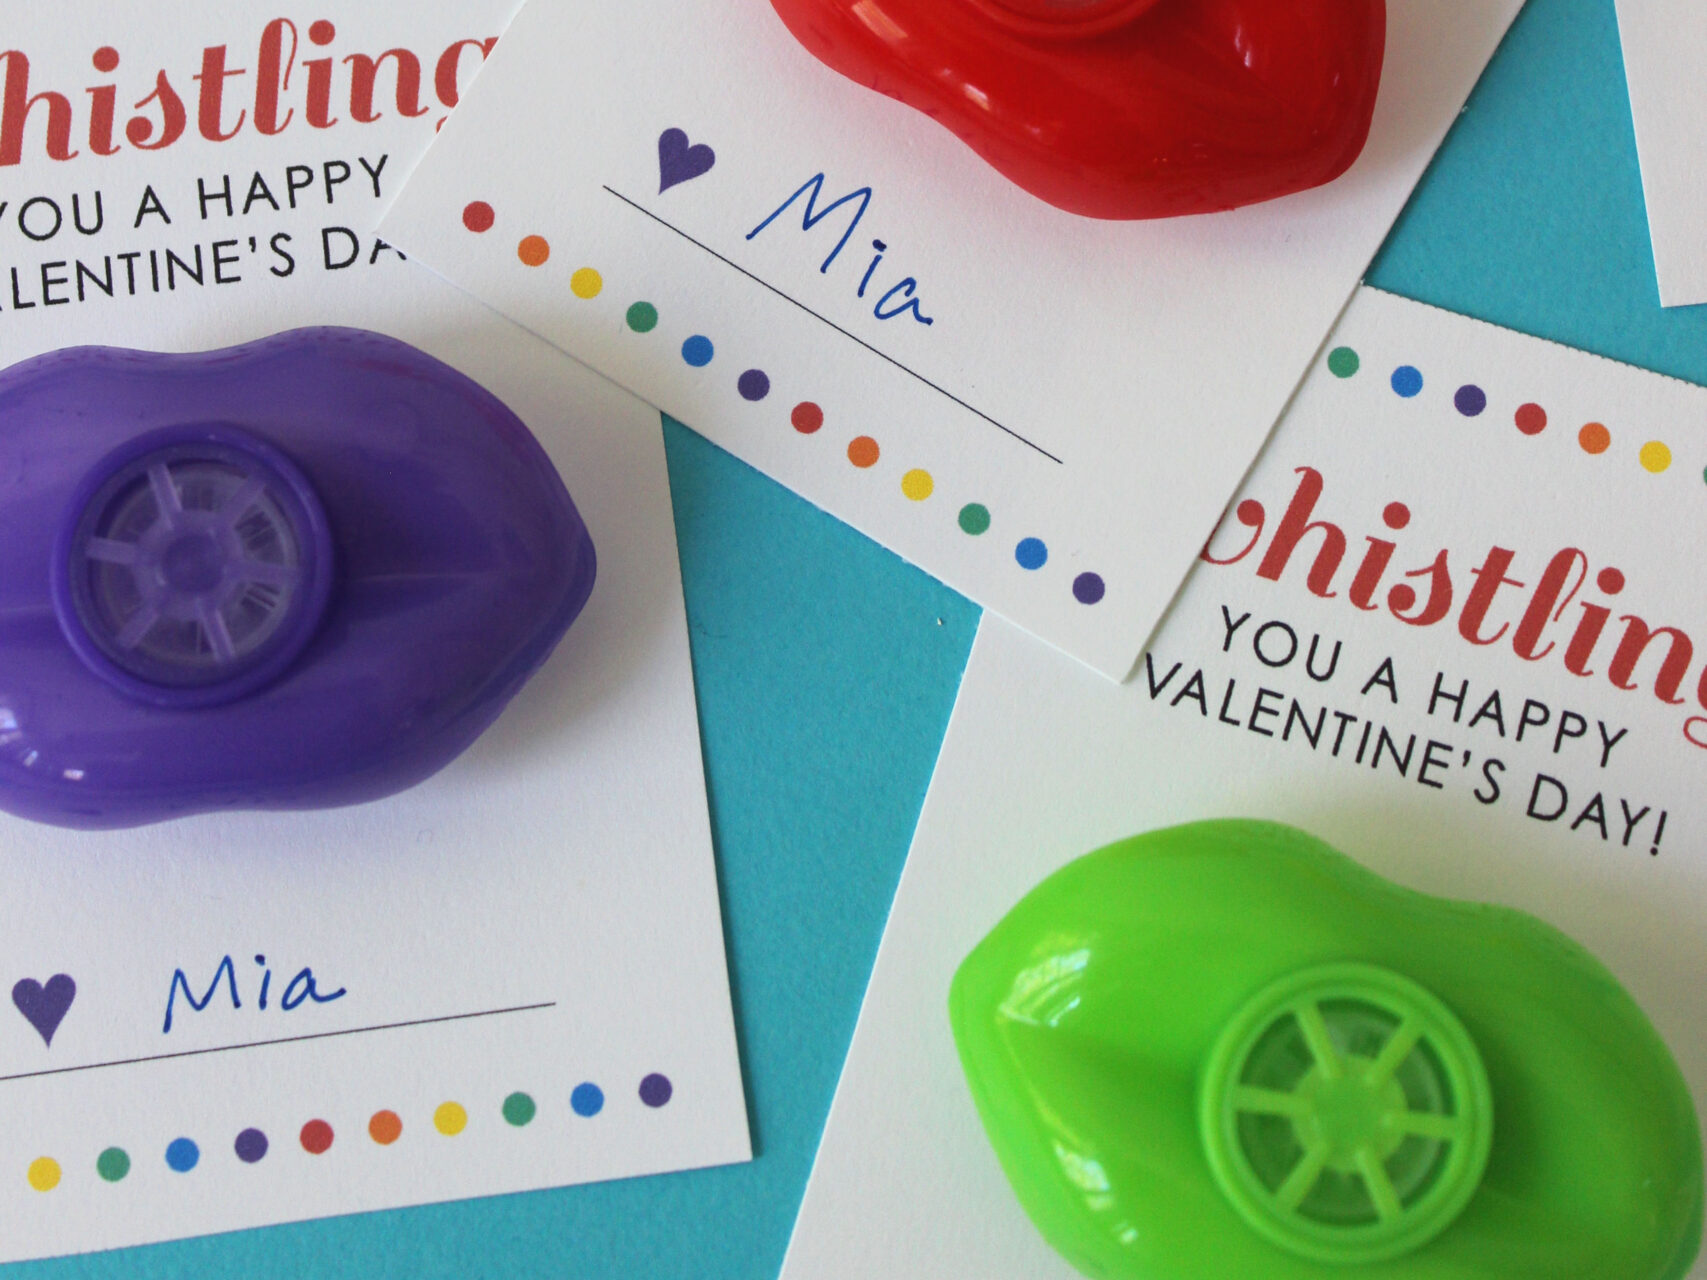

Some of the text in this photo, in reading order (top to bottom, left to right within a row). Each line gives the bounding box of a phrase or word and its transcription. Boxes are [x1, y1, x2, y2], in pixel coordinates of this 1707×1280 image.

[0, 17, 499, 167] histlin
[134, 184, 171, 228] A
[197, 154, 389, 220] HAPPY
[745, 172, 934, 326] Mia
[0, 231, 296, 311] LENTINE'S
[1145, 652, 1668, 856] VALENTINE'S DAY!
[1221, 605, 1628, 768] YOU A HAPPY
[162, 954, 347, 1035] Mia
